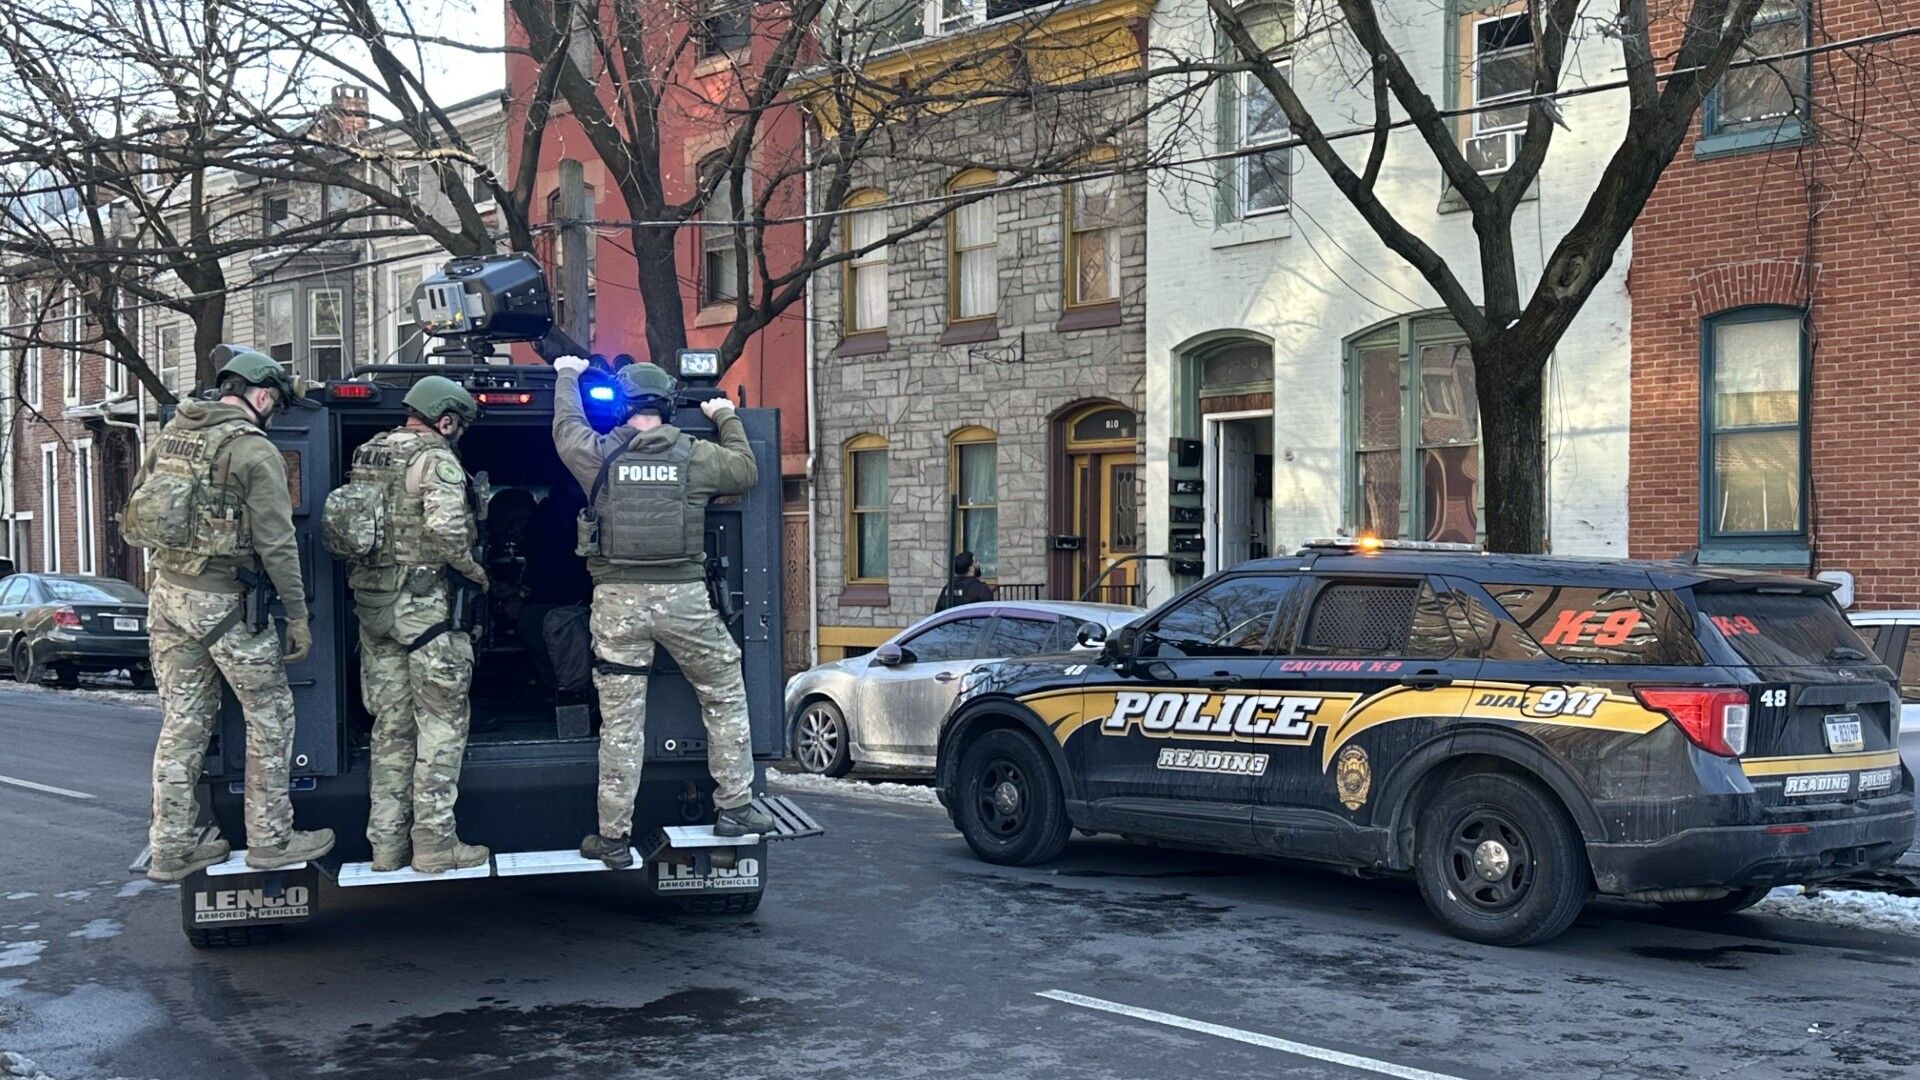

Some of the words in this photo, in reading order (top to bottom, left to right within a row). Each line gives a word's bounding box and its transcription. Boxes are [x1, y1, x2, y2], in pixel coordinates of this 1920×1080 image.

[161, 438, 205, 459] POLICE
[354, 447, 392, 467] POLICE
[618, 465, 678, 481] POLICE
[1541, 607, 1643, 646] K-9
[1711, 614, 1760, 637] K-9
[1063, 664, 1088, 676] 48
[1280, 660, 1364, 672] CAUTION
[1367, 660, 1402, 672] K-9
[1476, 693, 1531, 709] DIAL
[1533, 688, 1607, 718] 911
[1760, 689, 1788, 707] 48
[1103, 690, 1324, 738] POLICE
[1158, 749, 1268, 775] READING
[1786, 775, 1849, 794] READING
[1859, 771, 1892, 790] POLICE
[659, 880, 703, 889] ARMORED
[715, 878, 758, 887] VEHICLES
[197, 909, 246, 920] ARMORED
[260, 905, 308, 917] VEHICLES
